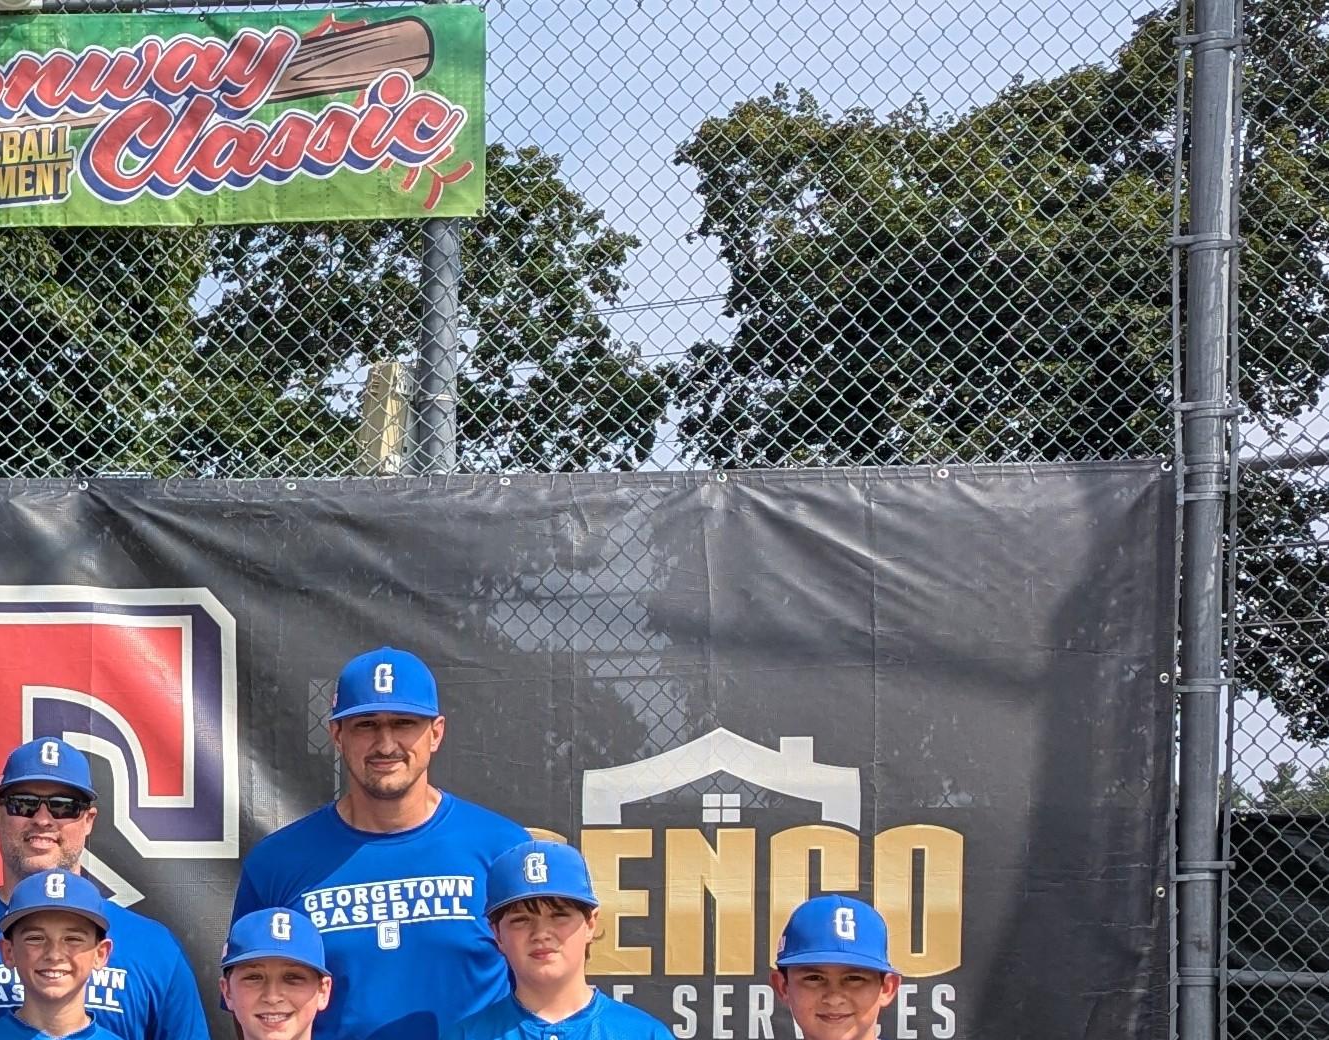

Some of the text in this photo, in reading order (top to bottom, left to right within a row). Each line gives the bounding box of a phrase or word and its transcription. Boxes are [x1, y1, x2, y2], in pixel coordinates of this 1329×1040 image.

[78, 68, 469, 202] Classic
[373, 663, 394, 693] G
[40, 741, 59, 766] G
[523, 852, 548, 883] G
[45, 873, 66, 898] G
[304, 879, 472, 912] GEORGETOWN
[524, 824, 964, 978] ENCO
[271, 912, 290, 941] G
[311, 897, 468, 928] BASEBALL
[833, 907, 856, 940] G
[377, 920, 400, 950] G
[672, 983, 956, 1040] SERES
